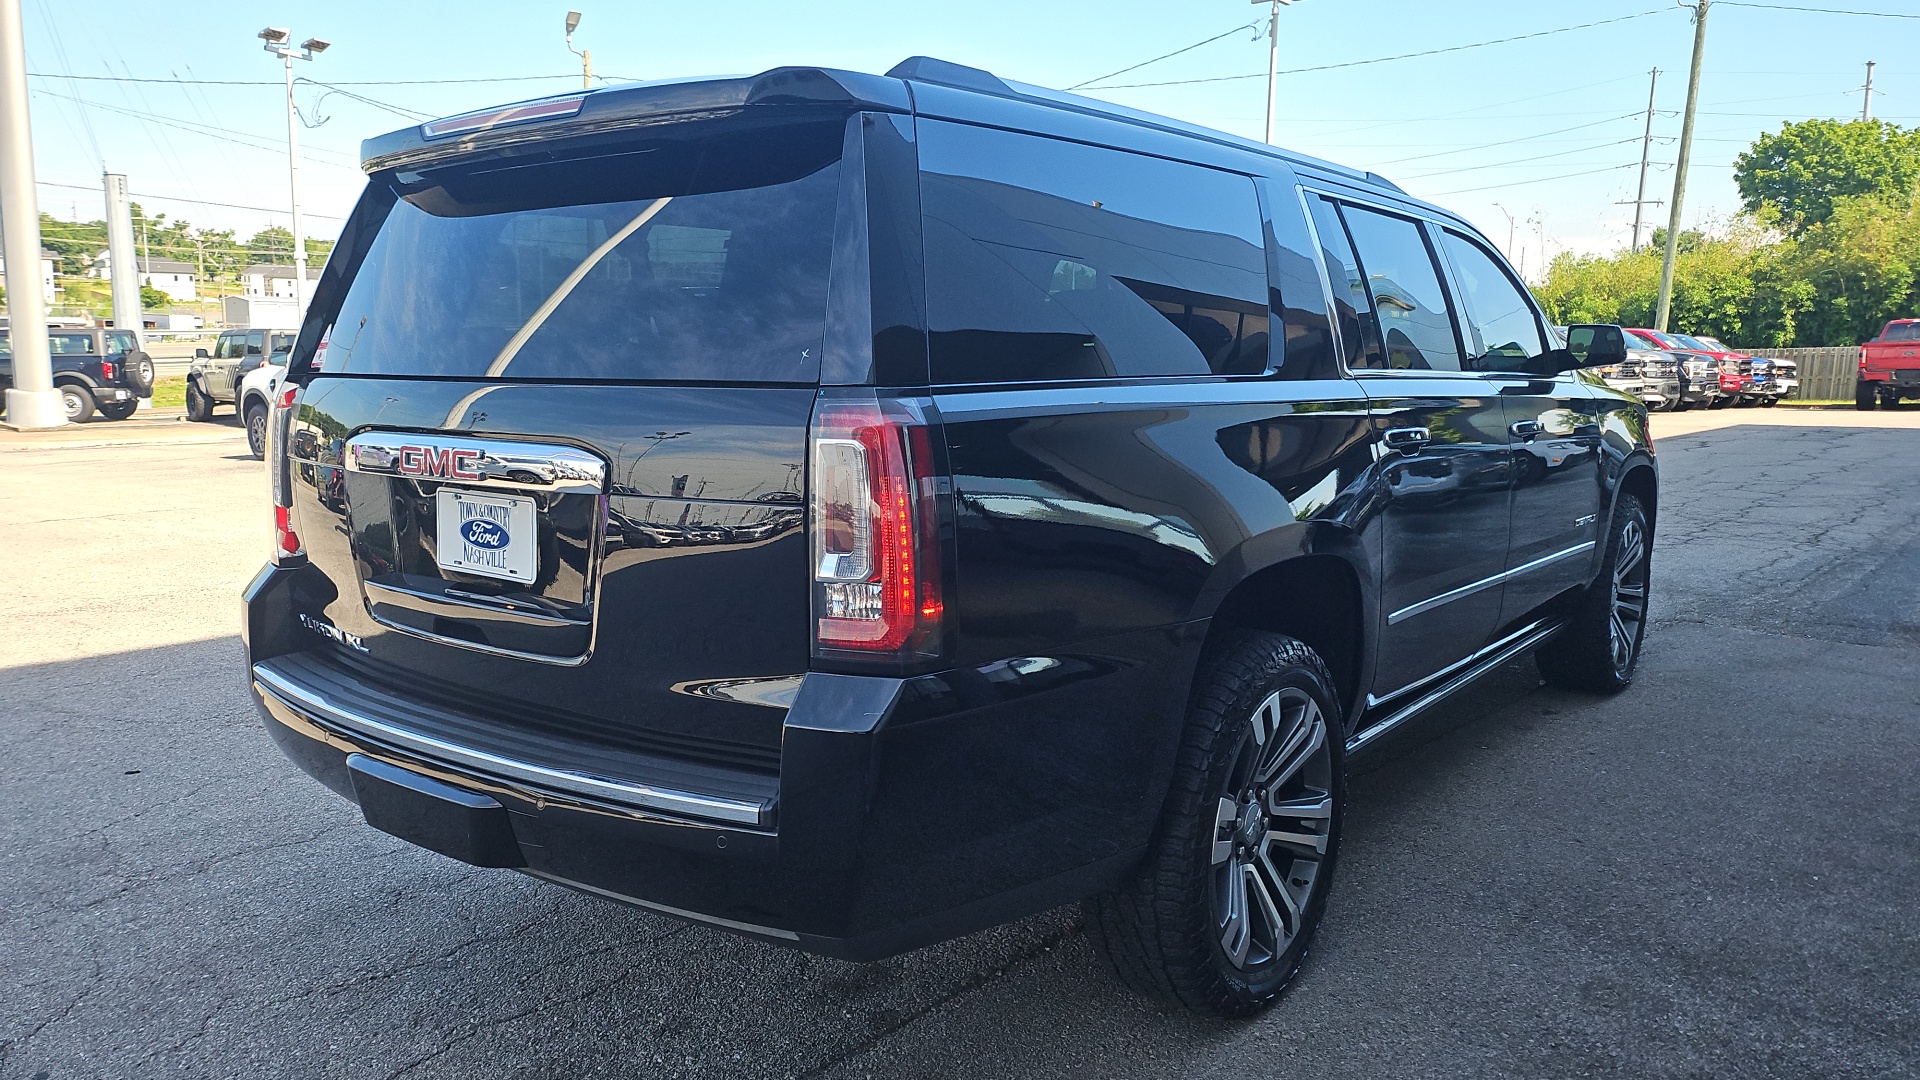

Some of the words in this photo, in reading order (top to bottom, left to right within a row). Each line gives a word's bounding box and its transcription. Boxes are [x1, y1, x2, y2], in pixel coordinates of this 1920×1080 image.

[399, 445, 484, 480] GMC
[458, 501, 479, 523] TOWN
[484, 504, 512, 532] COUNTRY
[469, 521, 501, 546] Ford
[463, 541, 507, 569] NASHVILLE
